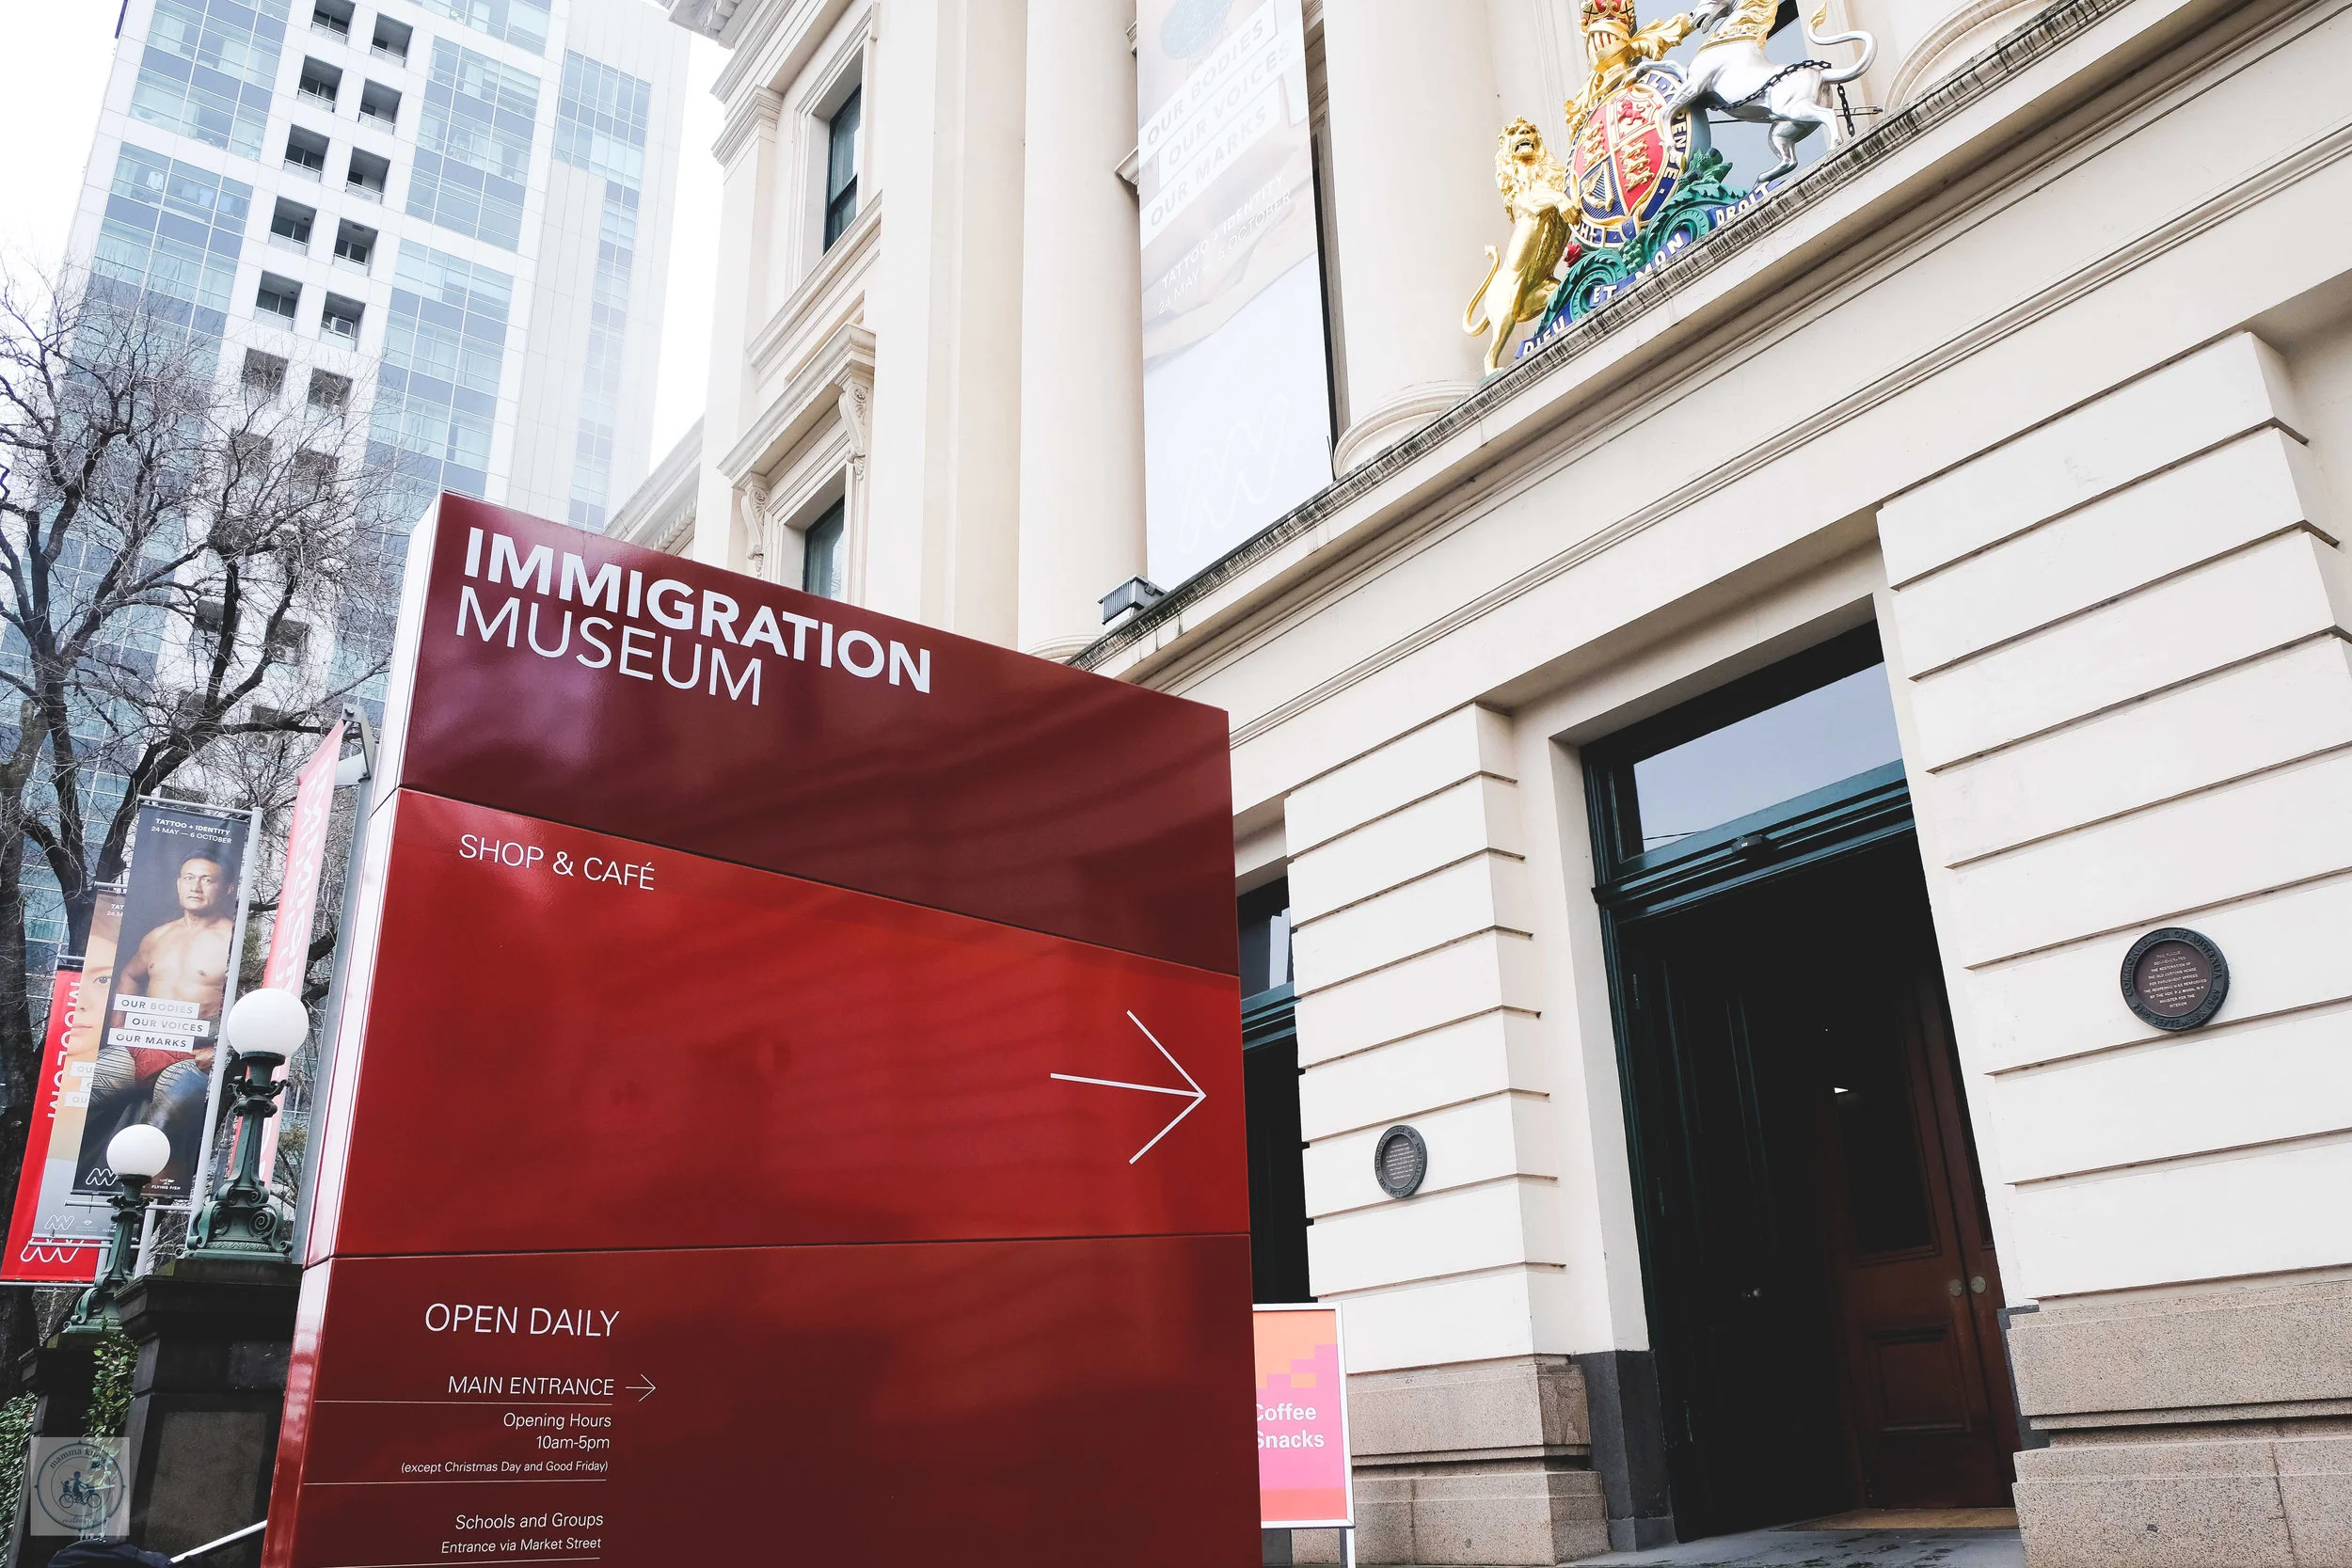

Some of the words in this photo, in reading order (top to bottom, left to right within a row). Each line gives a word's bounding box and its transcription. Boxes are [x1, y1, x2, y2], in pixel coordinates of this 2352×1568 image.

[1147, 99, 1184, 146] OUR
[1191, 19, 1263, 99] BODIES
[1168, 118, 1207, 166] OUR
[1212, 39, 1293, 120] VOICES
[1151, 182, 1189, 226] OUR
[1196, 105, 1266, 182] MARKS
[1161, 240, 1209, 289] TATTOO
[1223, 172, 1284, 234] IDENTITY
[1158, 295, 1171, 315] 24
[1174, 270, 1200, 299] MAY
[1228, 189, 1292, 250] OCTOBER
[1592, 284, 1618, 304] ET
[1715, 181, 1771, 226] DROIT
[464, 527, 930, 694] IMMIGRATION
[455, 585, 762, 706] MUSEUM
[155, 818, 187, 829] TATTOO
[195, 825, 230, 835] IDENTITY
[162, 827, 180, 835] MAY
[197, 833, 232, 844] OCTOBER
[458, 834, 545, 869] SHOP
[552, 851, 574, 877] &
[583, 857, 656, 891] CAFÉ
[2174, 930, 2187, 940] OF
[2189, 934, 2223, 978] AUSTRALIA
[121, 999, 146, 1008] OUR
[151, 1003, 194, 1014] BODIES
[132, 1018, 156, 1028] OUR
[161, 1021, 203, 1032] VOICES
[116, 1033, 141, 1043] OUR
[145, 1037, 187, 1047] MARKS
[425, 1303, 518, 1334] OPEN
[530, 1307, 620, 1338] DAILY
[448, 1375, 503, 1394] MAIN
[510, 1377, 614, 1396] ENTRANCE
[503, 1412, 564, 1430] Opening
[569, 1413, 612, 1428] Hours
[535, 1435, 611, 1452] 10am-5pm
[1258, 1430, 1325, 1449] Snacks
[401, 1462, 441, 1474] (except
[444, 1462, 498, 1473] Christmas
[501, 1462, 521, 1475] Day
[524, 1462, 543, 1472] and
[546, 1462, 573, 1472] Good
[576, 1461, 608, 1473] Friday)
[455, 1514, 516, 1530] Schools
[519, 1514, 547, 1528] and
[551, 1513, 604, 1529] Groups
[441, 1541, 496, 1554] Entrance
[501, 1540, 516, 1551] via
[520, 1539, 563, 1551] Market
[565, 1538, 602, 1549] Street
